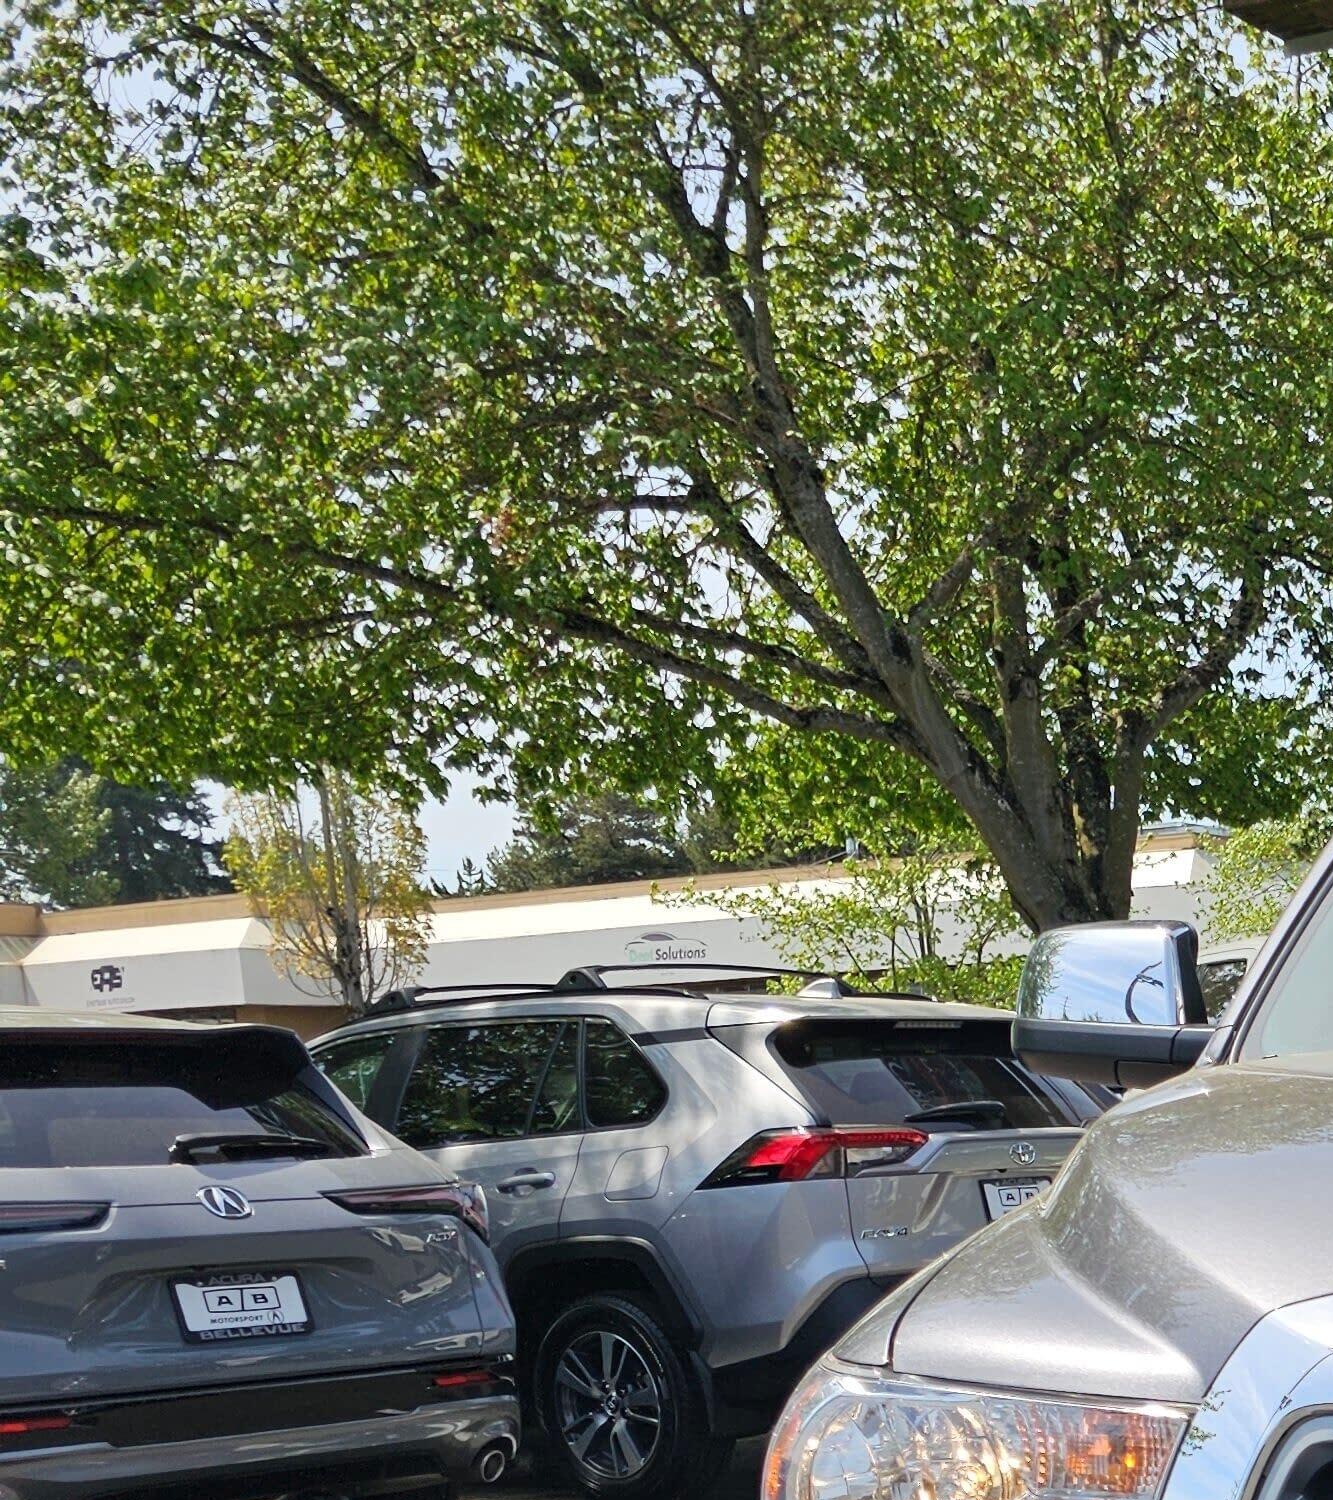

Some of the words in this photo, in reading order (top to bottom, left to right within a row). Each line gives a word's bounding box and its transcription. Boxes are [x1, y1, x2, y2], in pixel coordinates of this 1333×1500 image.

[655, 945, 706, 961] Solutions
[208, 1273, 267, 1286] ACURA
[210, 1314, 264, 1324] MOTORSPORT
[201, 1322, 305, 1340] BELLEVUE
